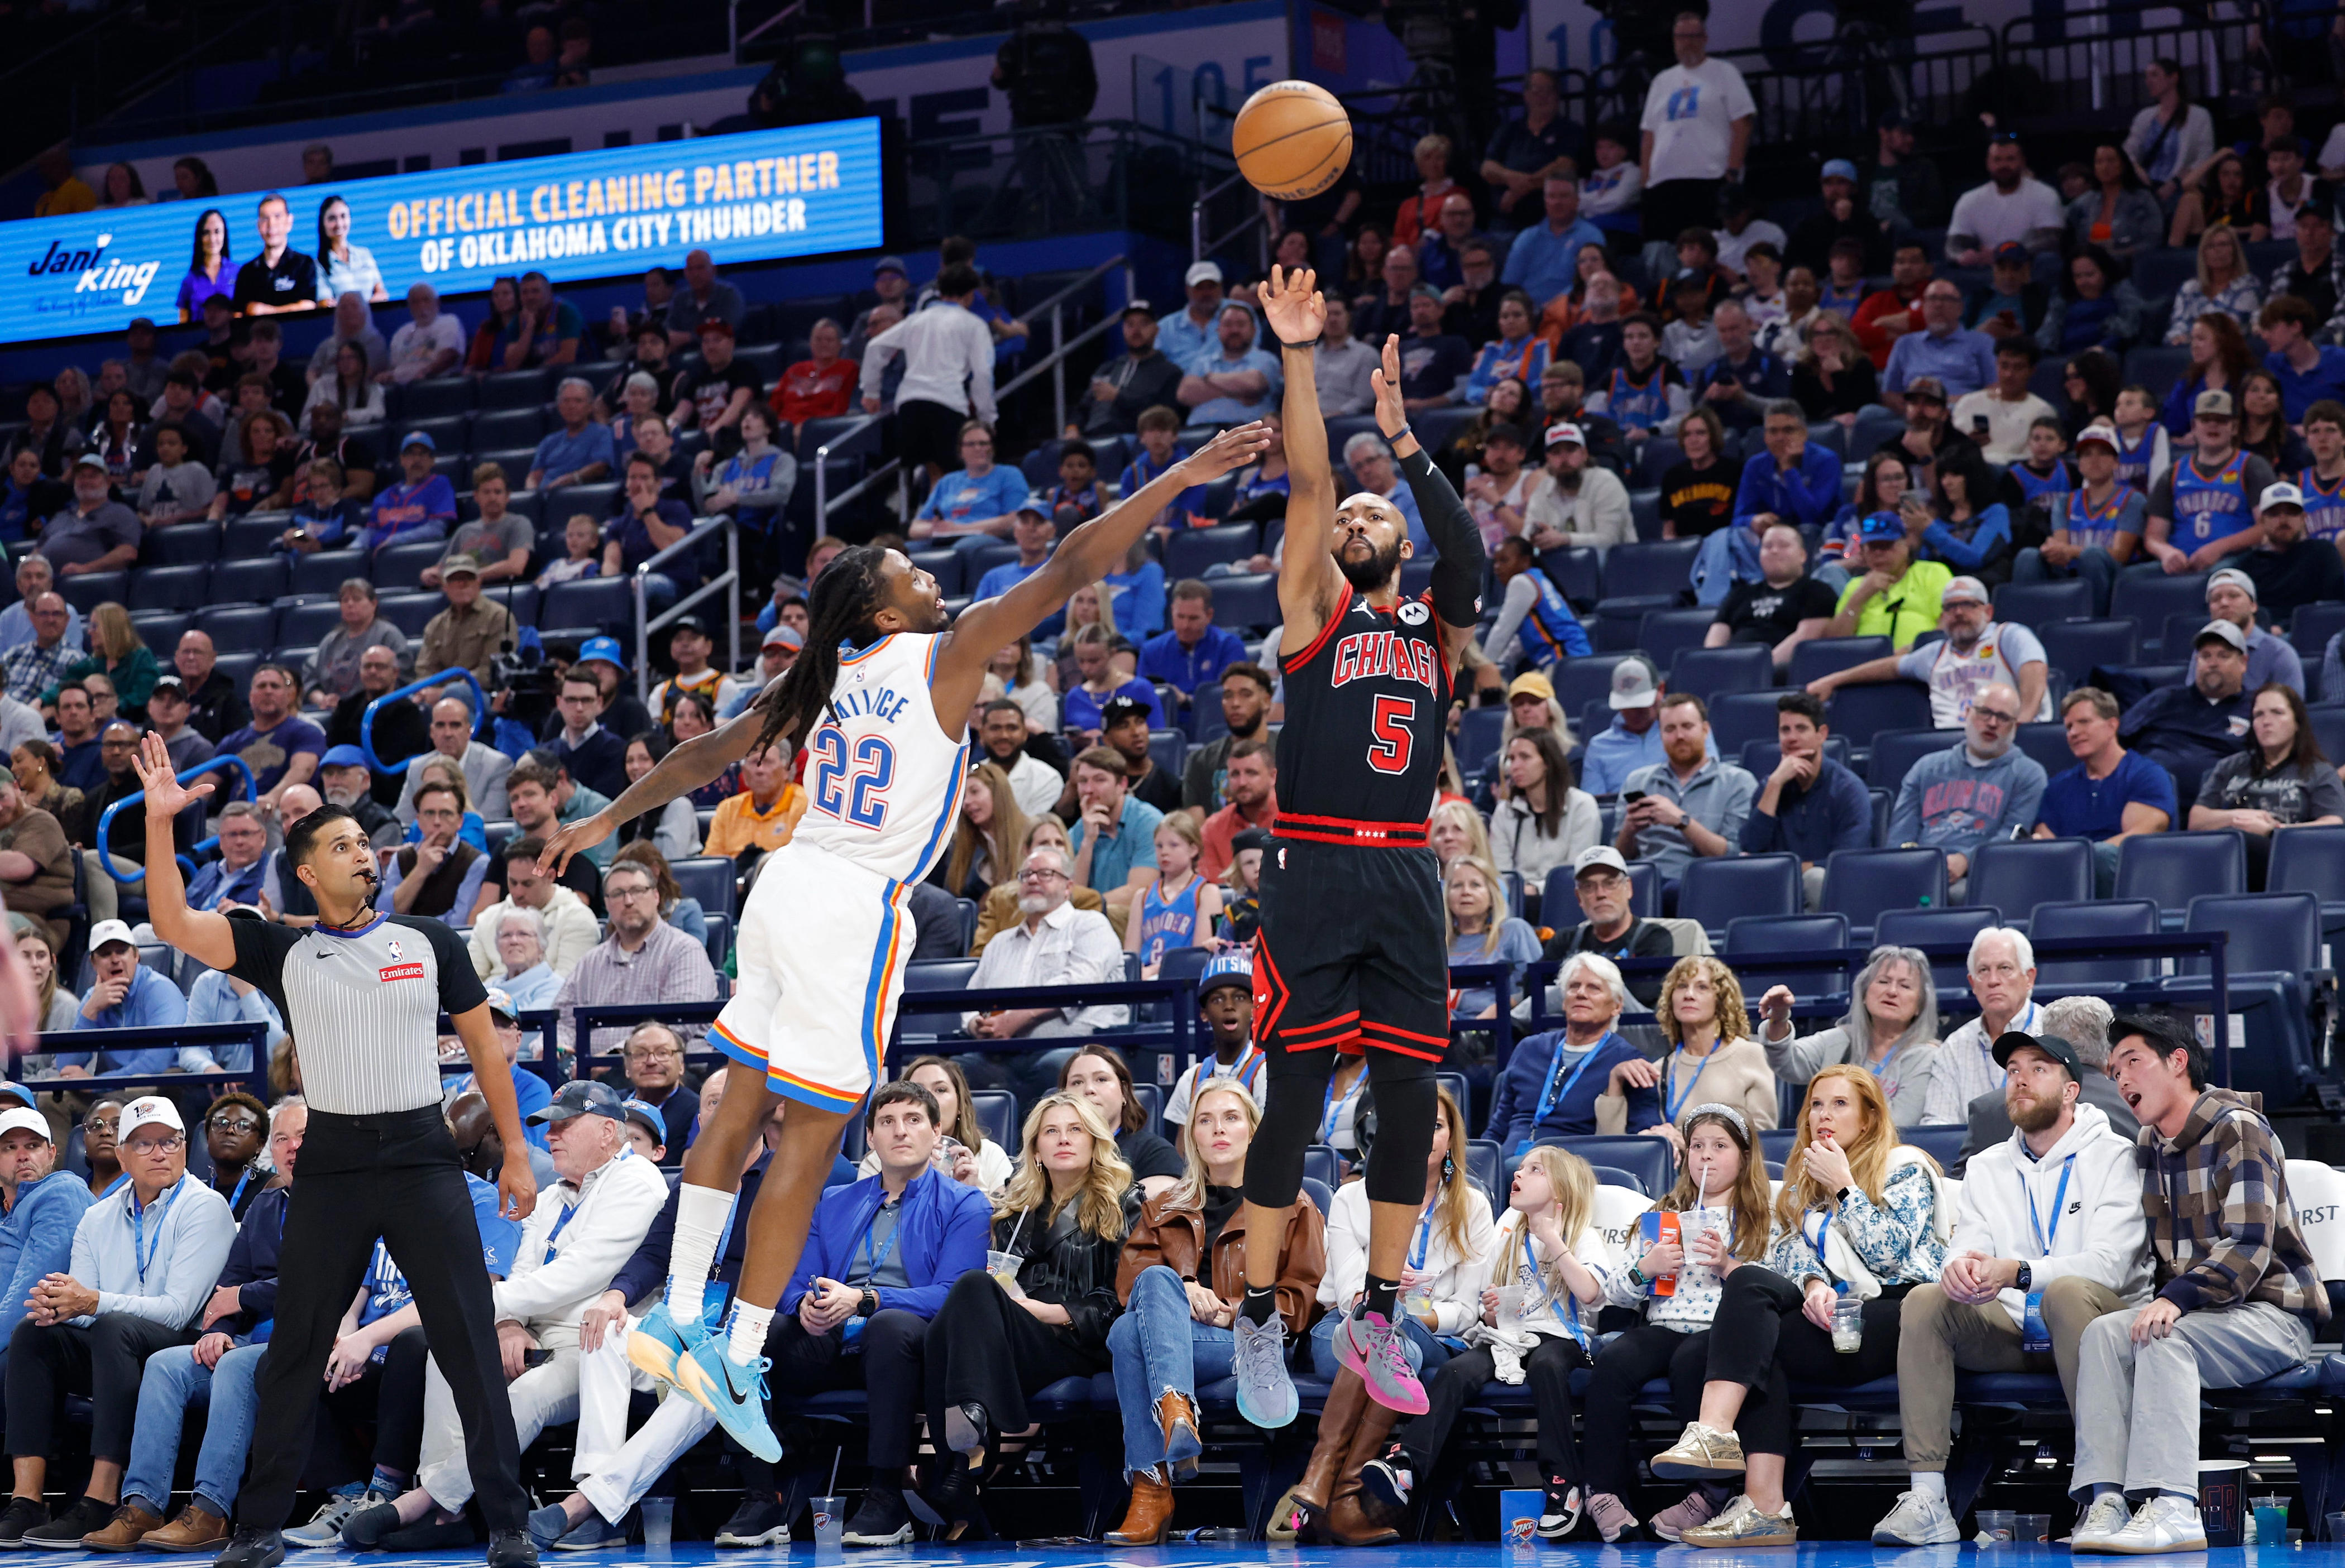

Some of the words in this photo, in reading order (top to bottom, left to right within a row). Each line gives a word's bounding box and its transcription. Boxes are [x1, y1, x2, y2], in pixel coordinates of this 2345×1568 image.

[387, 189, 524, 239] OFFICIAL
[531, 169, 686, 222] CLEANING
[695, 150, 839, 204] PARTNER
[420, 237, 454, 272] OF
[458, 220, 607, 268] OKLAHOMA
[612, 212, 673, 252] CITY
[677, 198, 807, 244] THUNDER
[29, 237, 111, 275] Jani
[74, 258, 161, 305] king
[2194, 510, 2211, 538] 6
[1331, 630, 1438, 702] CHIAGO
[1366, 693, 1416, 776] 5
[813, 723, 896, 832] 22
[1151, 937, 1165, 965] 2
[1217, 956, 1238, 973] IT'S
[381, 967, 423, 980] Emirates
[2296, 1205, 2340, 1226] IRST
[1514, 1522, 1533, 1536] OKC
